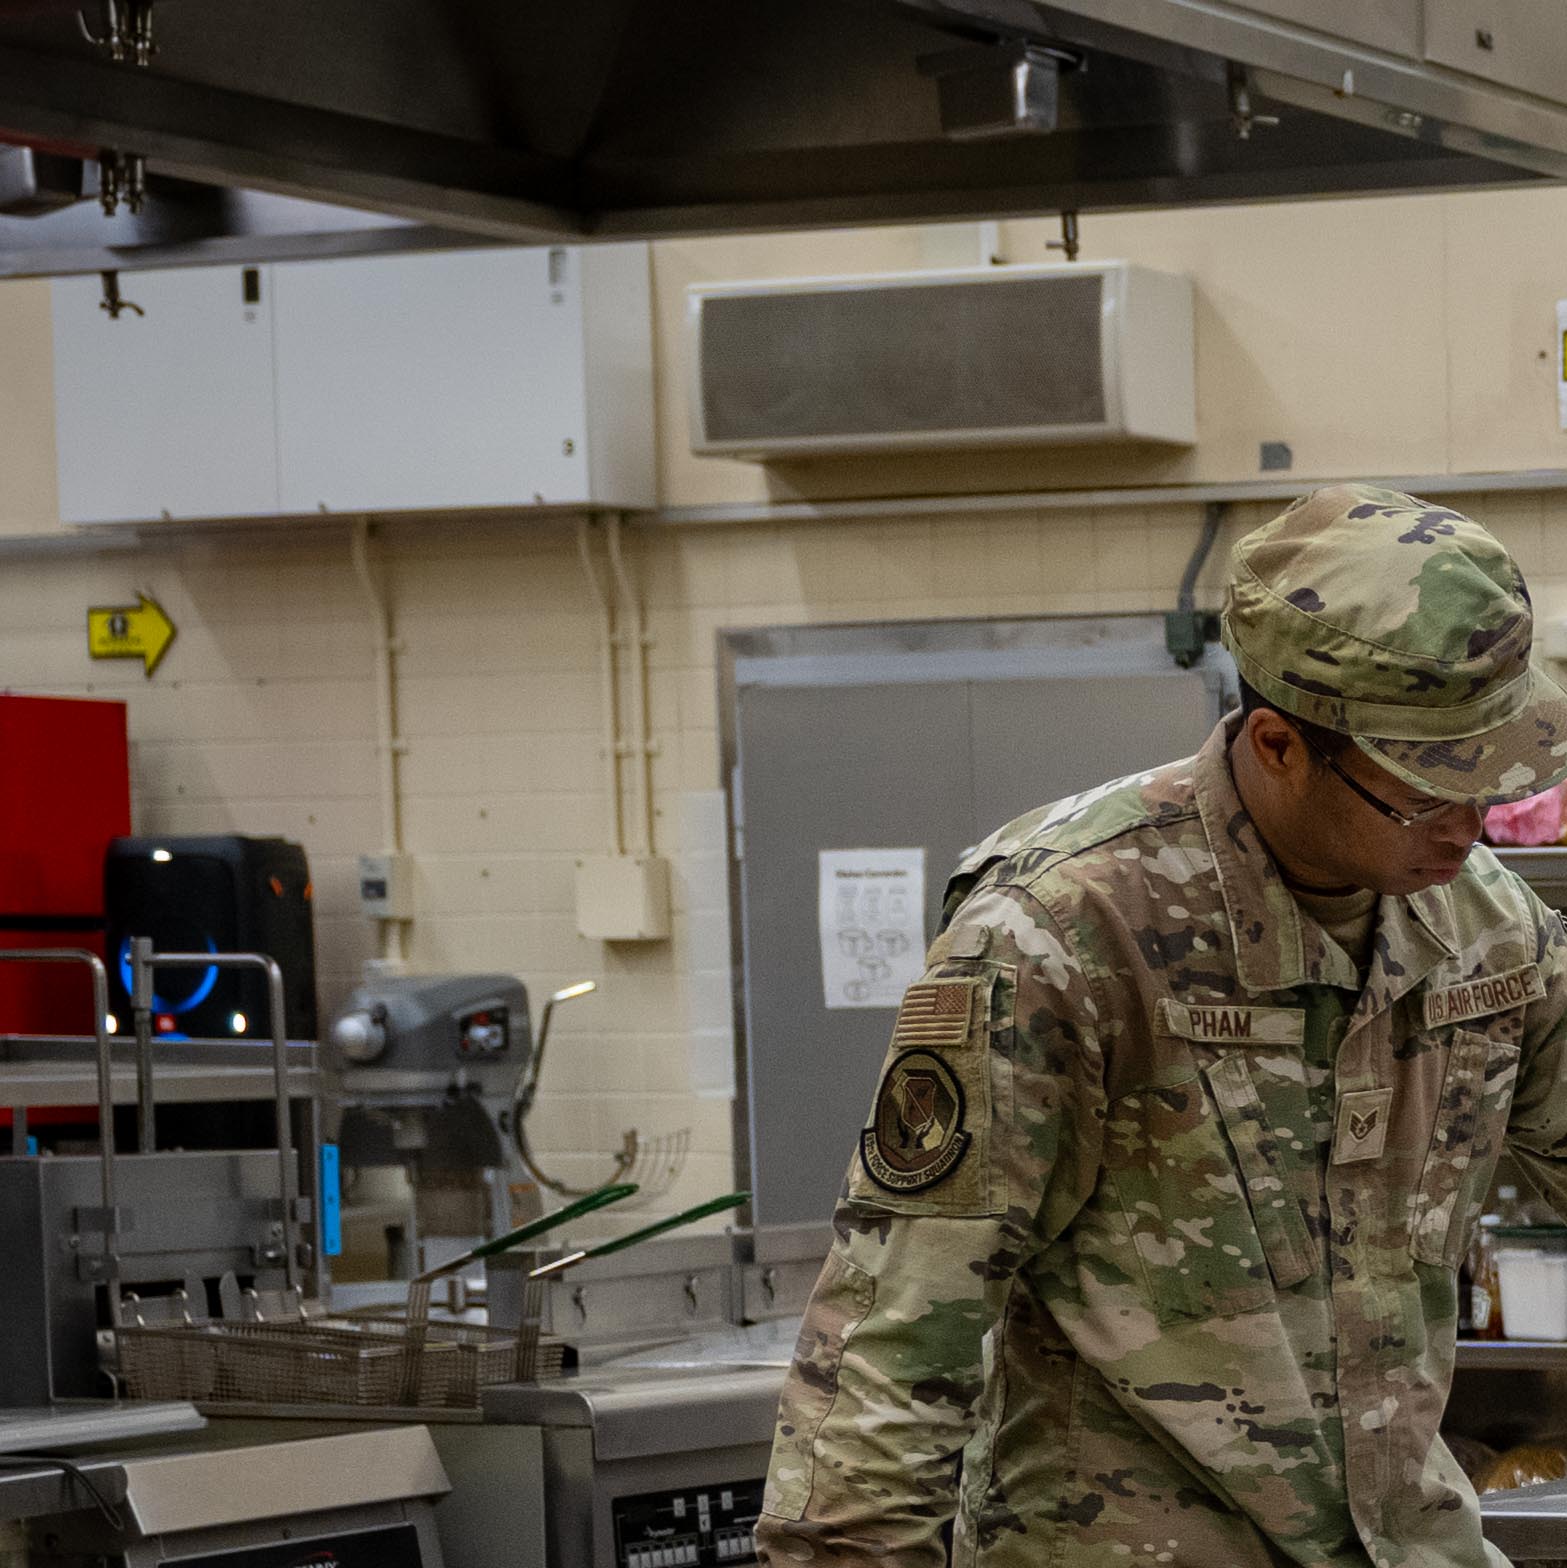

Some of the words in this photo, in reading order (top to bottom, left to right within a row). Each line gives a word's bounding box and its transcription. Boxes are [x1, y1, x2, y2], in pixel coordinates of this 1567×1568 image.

[1447, 989, 1474, 1019] AIR
[1472, 969, 1536, 1012] FORCE
[1190, 1010, 1252, 1037] PHAM
[924, 1136, 963, 1179] SQUADRON
